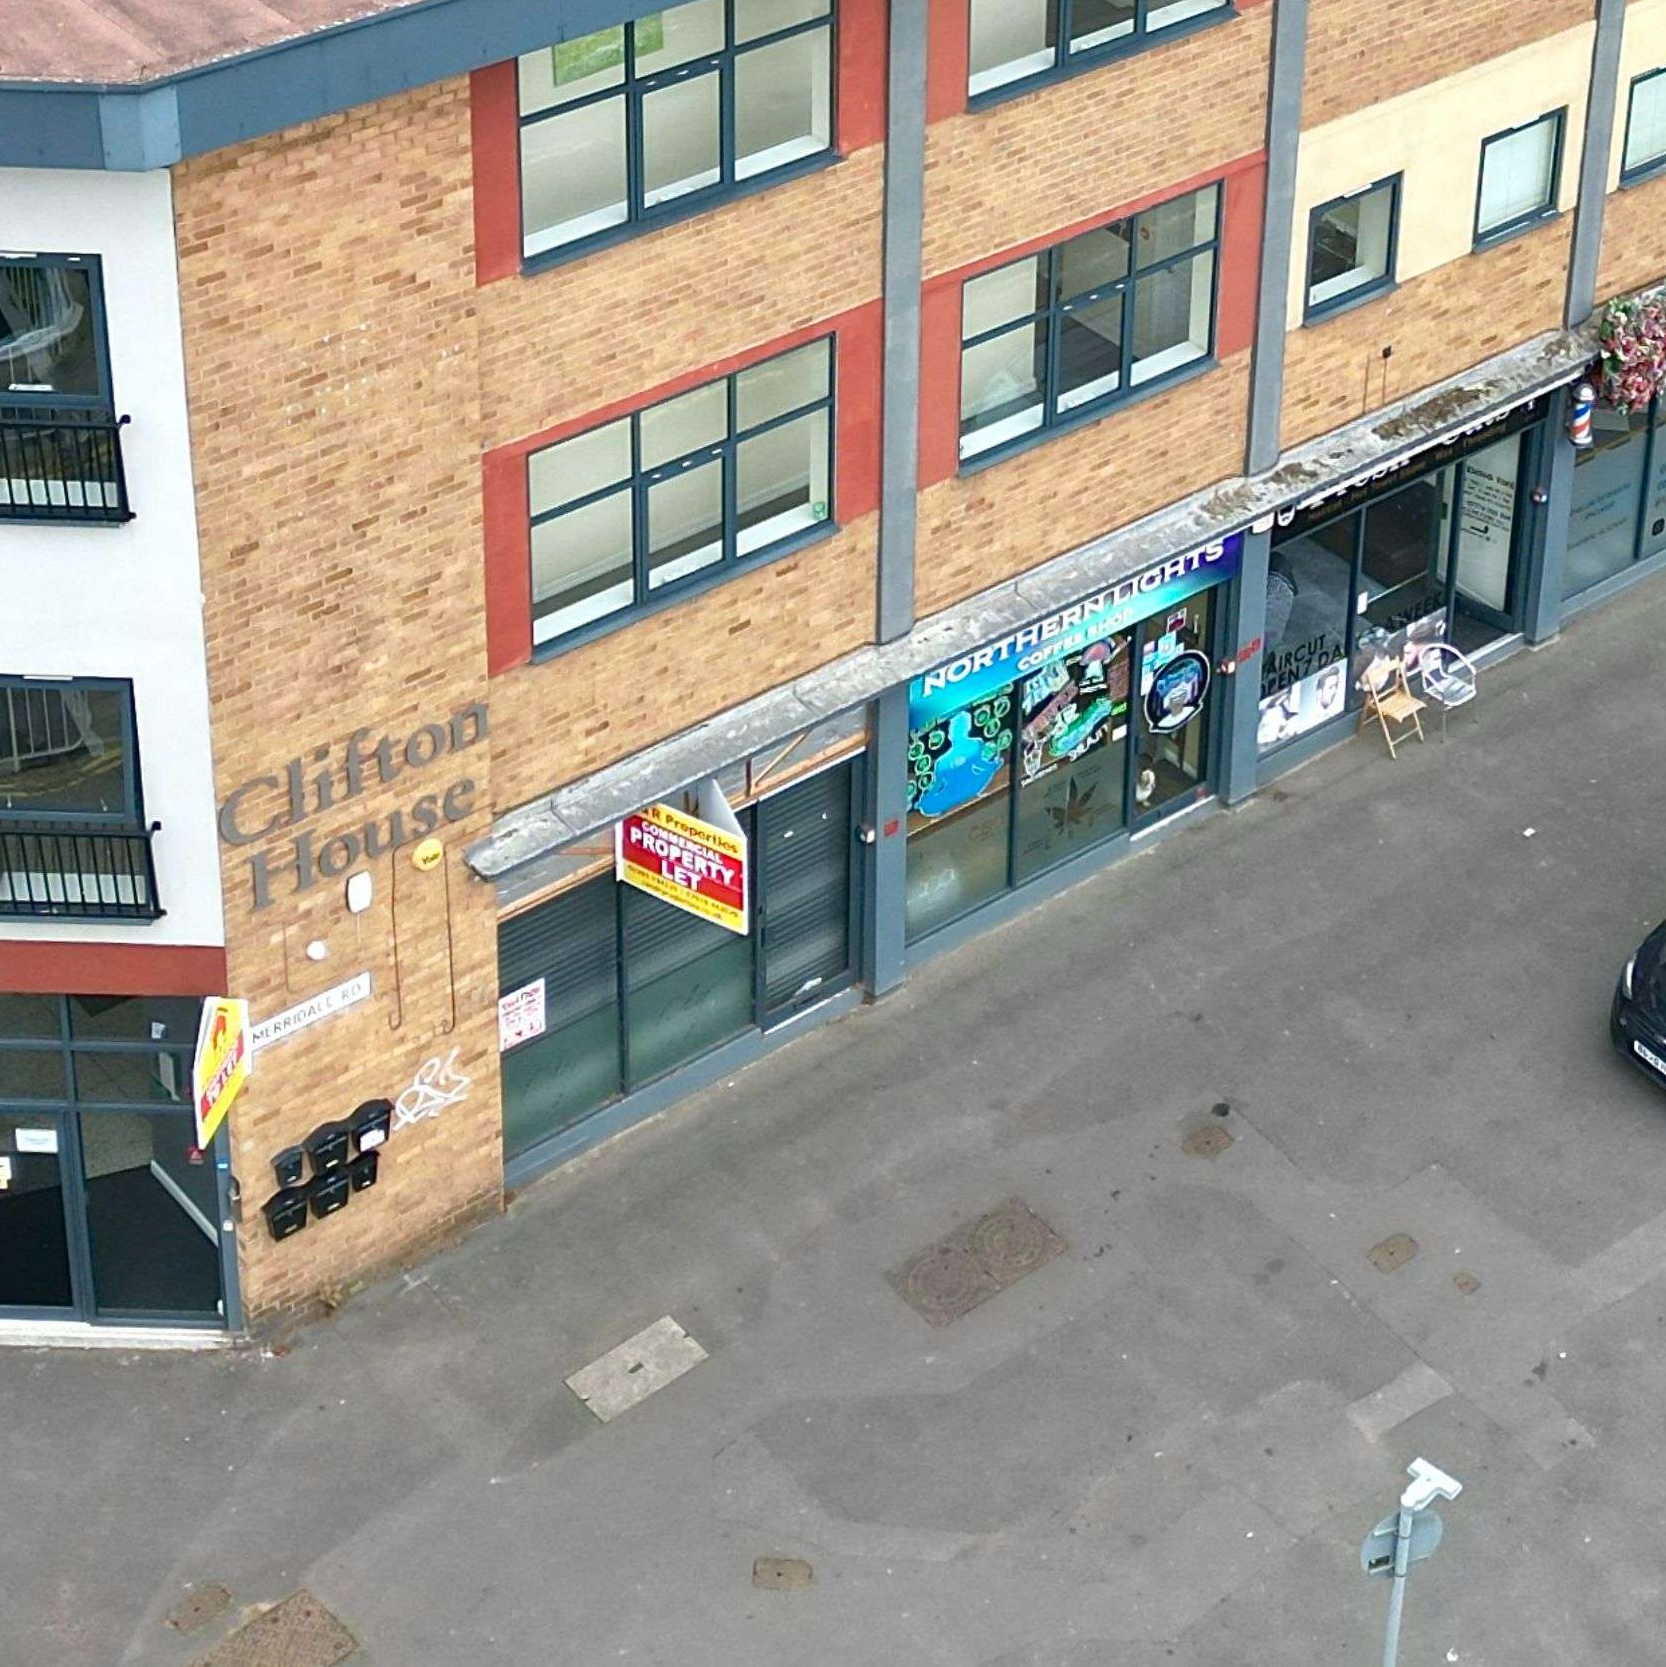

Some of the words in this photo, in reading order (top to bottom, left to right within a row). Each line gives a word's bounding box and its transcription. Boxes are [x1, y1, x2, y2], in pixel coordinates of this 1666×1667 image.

[921, 591, 1108, 697] NORTHERN
[1112, 538, 1225, 605] LIGHTS
[1016, 631, 1085, 672] COFFEE
[1087, 607, 1134, 636] SHOP
[218, 700, 490, 846] Clifton
[247, 777, 476, 913] House
[629, 825, 735, 886] PROPERTY
[640, 820, 724, 865] COMMERCIAL
[665, 813, 739, 854] Properties
[661, 859, 701, 891] LET
[252, 998, 334, 1044] MERRIDALE
